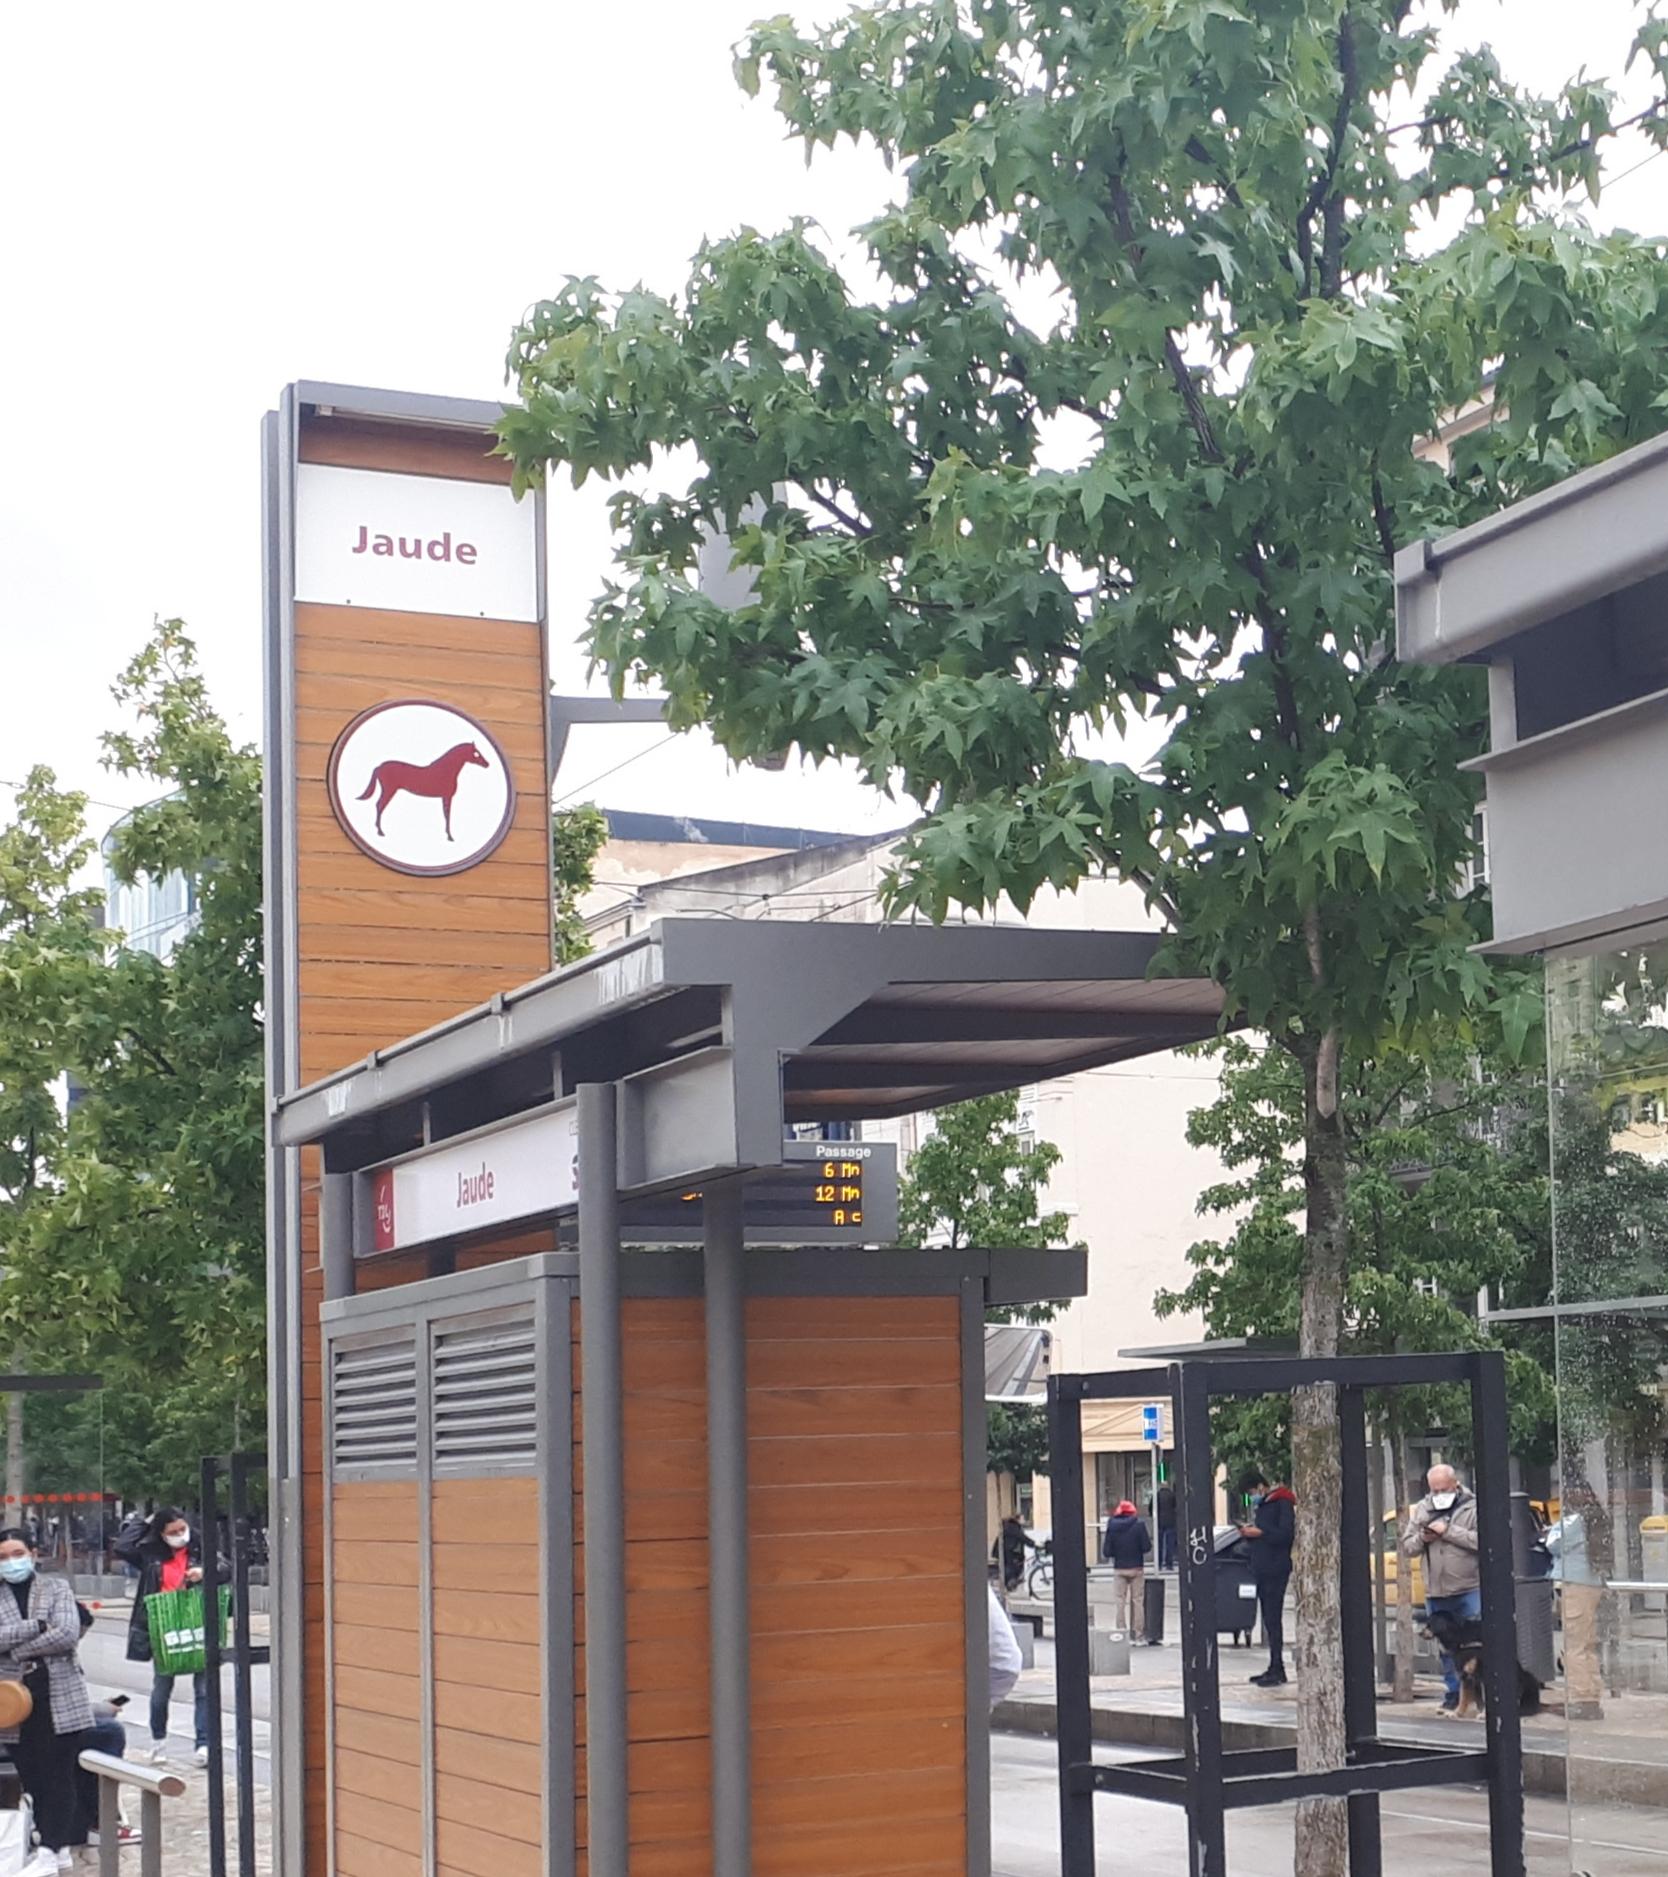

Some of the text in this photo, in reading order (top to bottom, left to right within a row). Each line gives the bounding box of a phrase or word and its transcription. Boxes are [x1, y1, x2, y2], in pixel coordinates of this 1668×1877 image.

[351, 525, 478, 566] Jaude
[815, 1144, 872, 1160] Passage
[824, 1161, 861, 1178] 6 Mn
[456, 1161, 495, 1209] Jaude
[815, 1185, 861, 1202] 12 Mn
[834, 1209, 845, 1225] A
